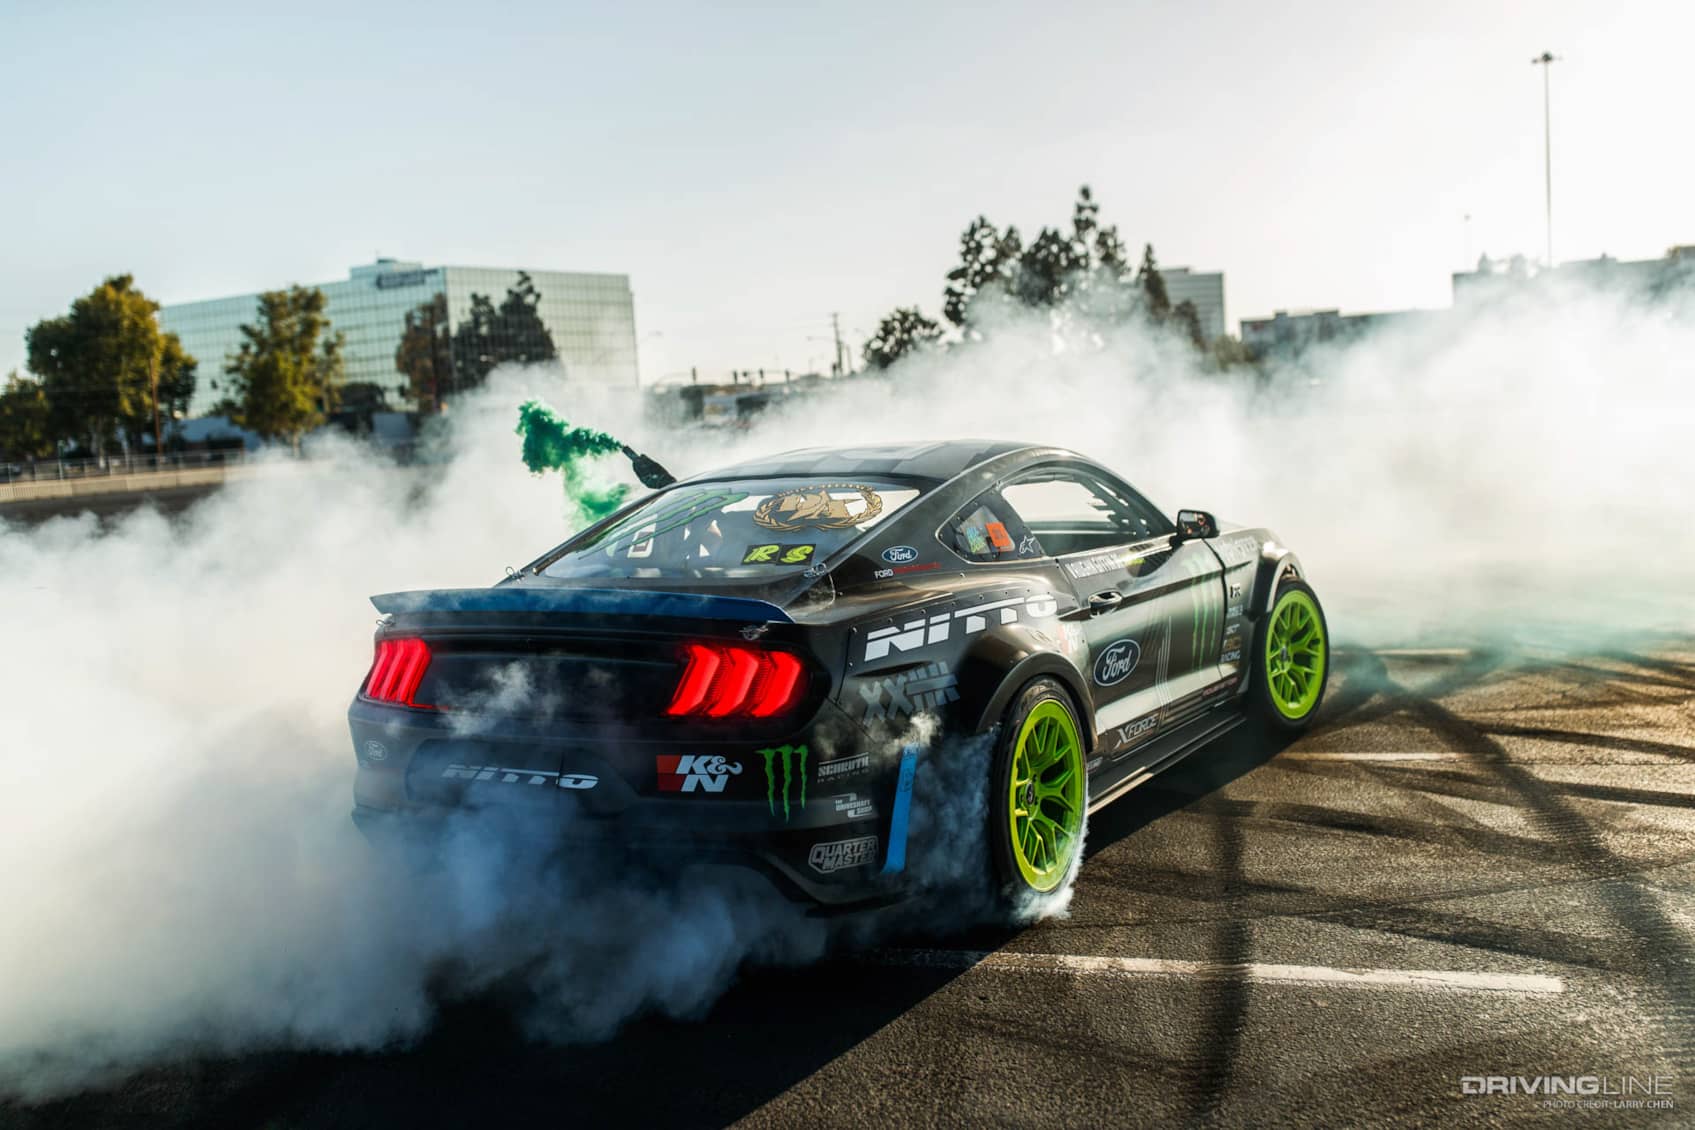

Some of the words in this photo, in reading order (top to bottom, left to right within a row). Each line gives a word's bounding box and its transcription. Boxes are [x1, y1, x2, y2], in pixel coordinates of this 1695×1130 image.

[889, 548, 913, 562] Ford
[873, 568, 894, 579] FORD
[864, 593, 1058, 662] NITTO
[1102, 645, 1133, 681] Ford
[440, 763, 600, 790] NITTO
[811, 838, 876, 864] QUARTER
[822, 850, 876, 870] MASTER
